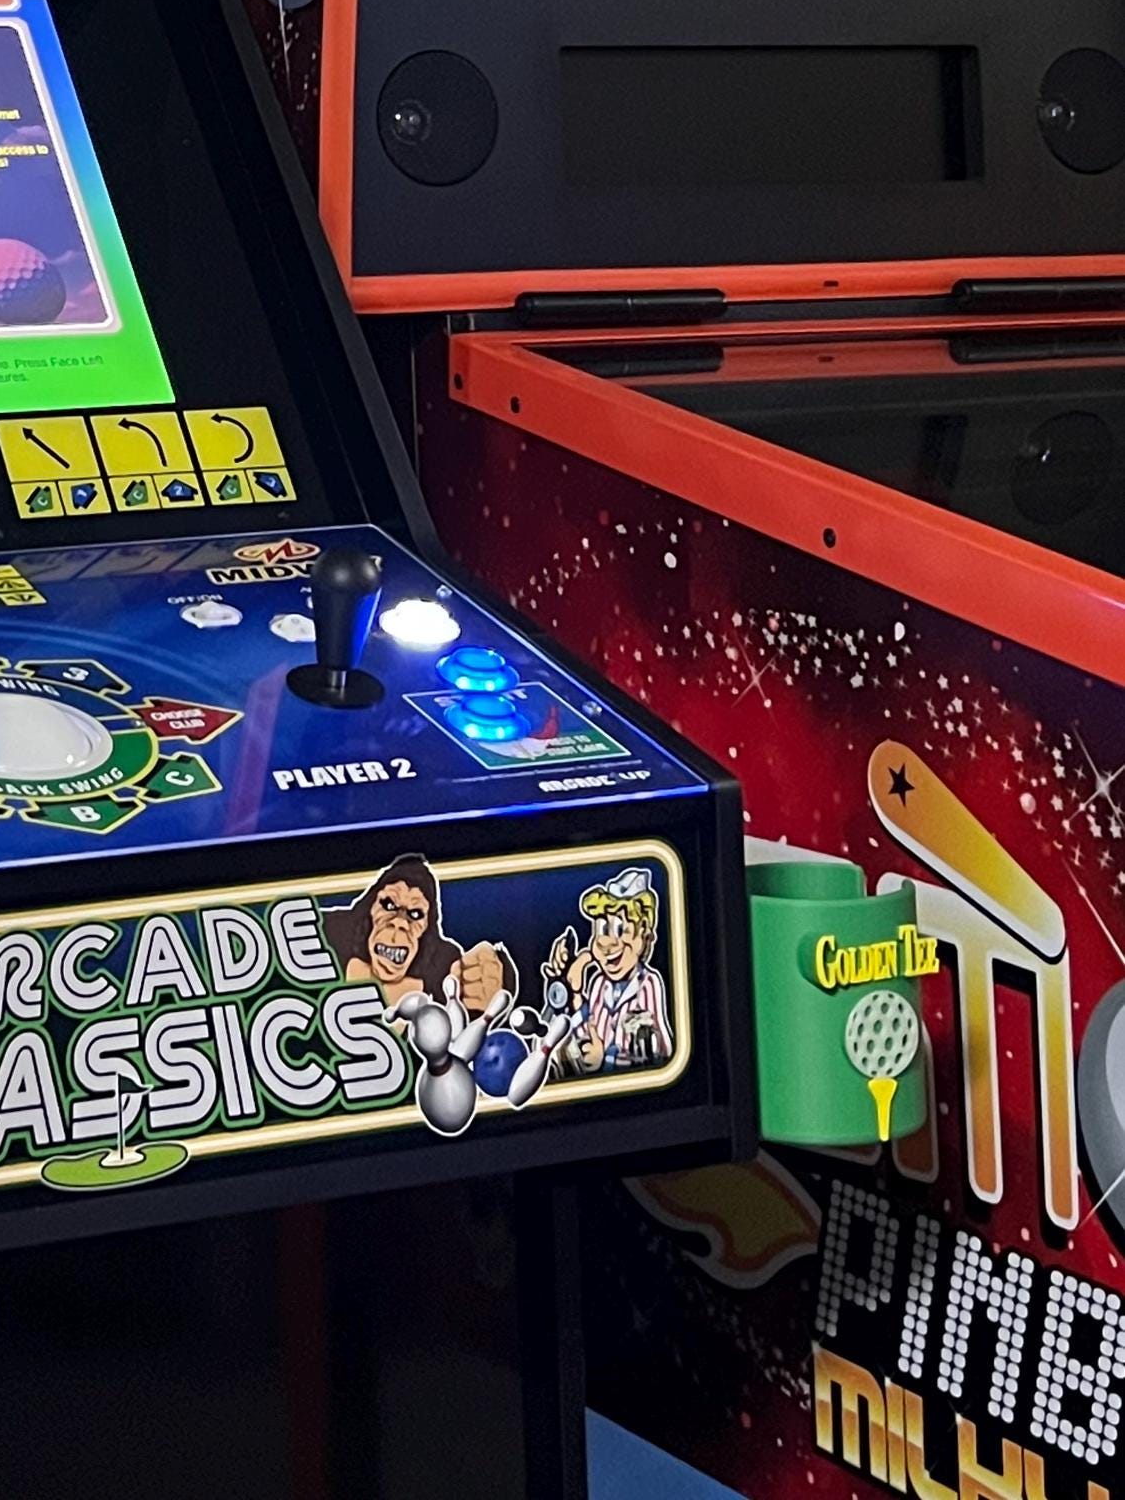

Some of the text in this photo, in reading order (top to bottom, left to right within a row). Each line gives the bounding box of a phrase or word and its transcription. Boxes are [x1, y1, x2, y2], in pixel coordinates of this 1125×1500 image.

[14, 358, 49, 369] Press
[62, 666, 90, 681] 3
[150, 708, 206, 722] CHOOSE
[169, 718, 206, 730] CLUB
[58, 765, 124, 796] SWING
[165, 770, 195, 787] C
[272, 757, 418, 790] PLAYER 2
[70, 805, 101, 823] B
